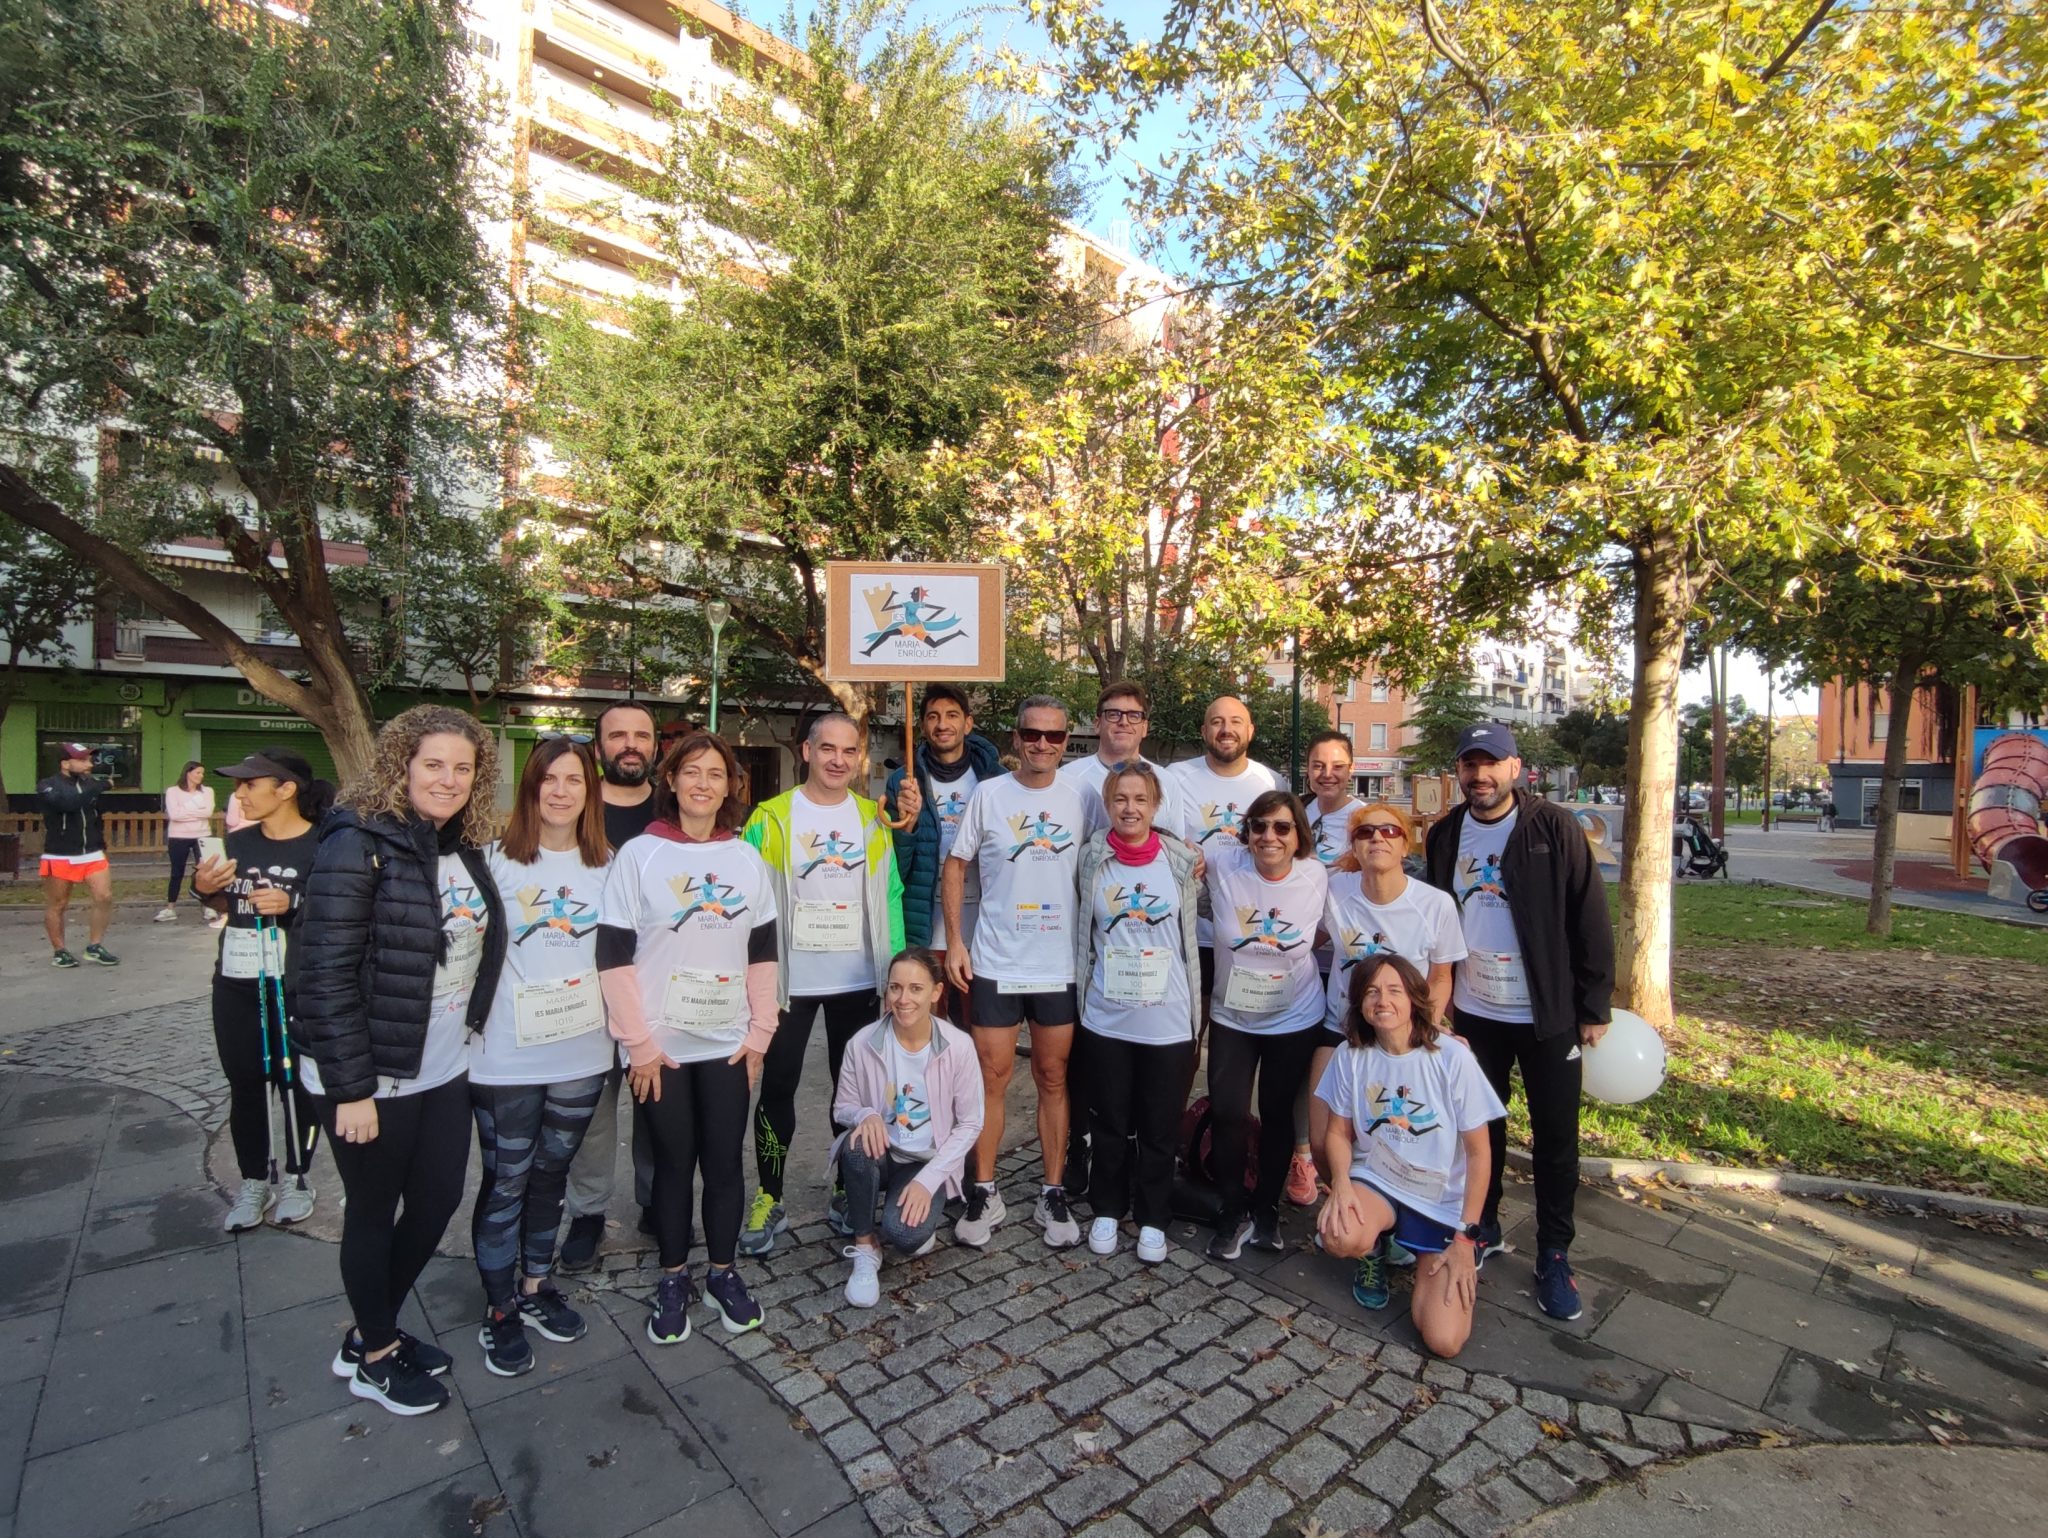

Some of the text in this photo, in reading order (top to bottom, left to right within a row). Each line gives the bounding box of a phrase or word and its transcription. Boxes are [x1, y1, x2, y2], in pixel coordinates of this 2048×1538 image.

[894, 640, 920, 649] MARIA
[542, 931, 566, 939] MARIA
[691, 996, 707, 1006] MARIA
[534, 999, 588, 1018] IES MARIA ENRIQUEZ
